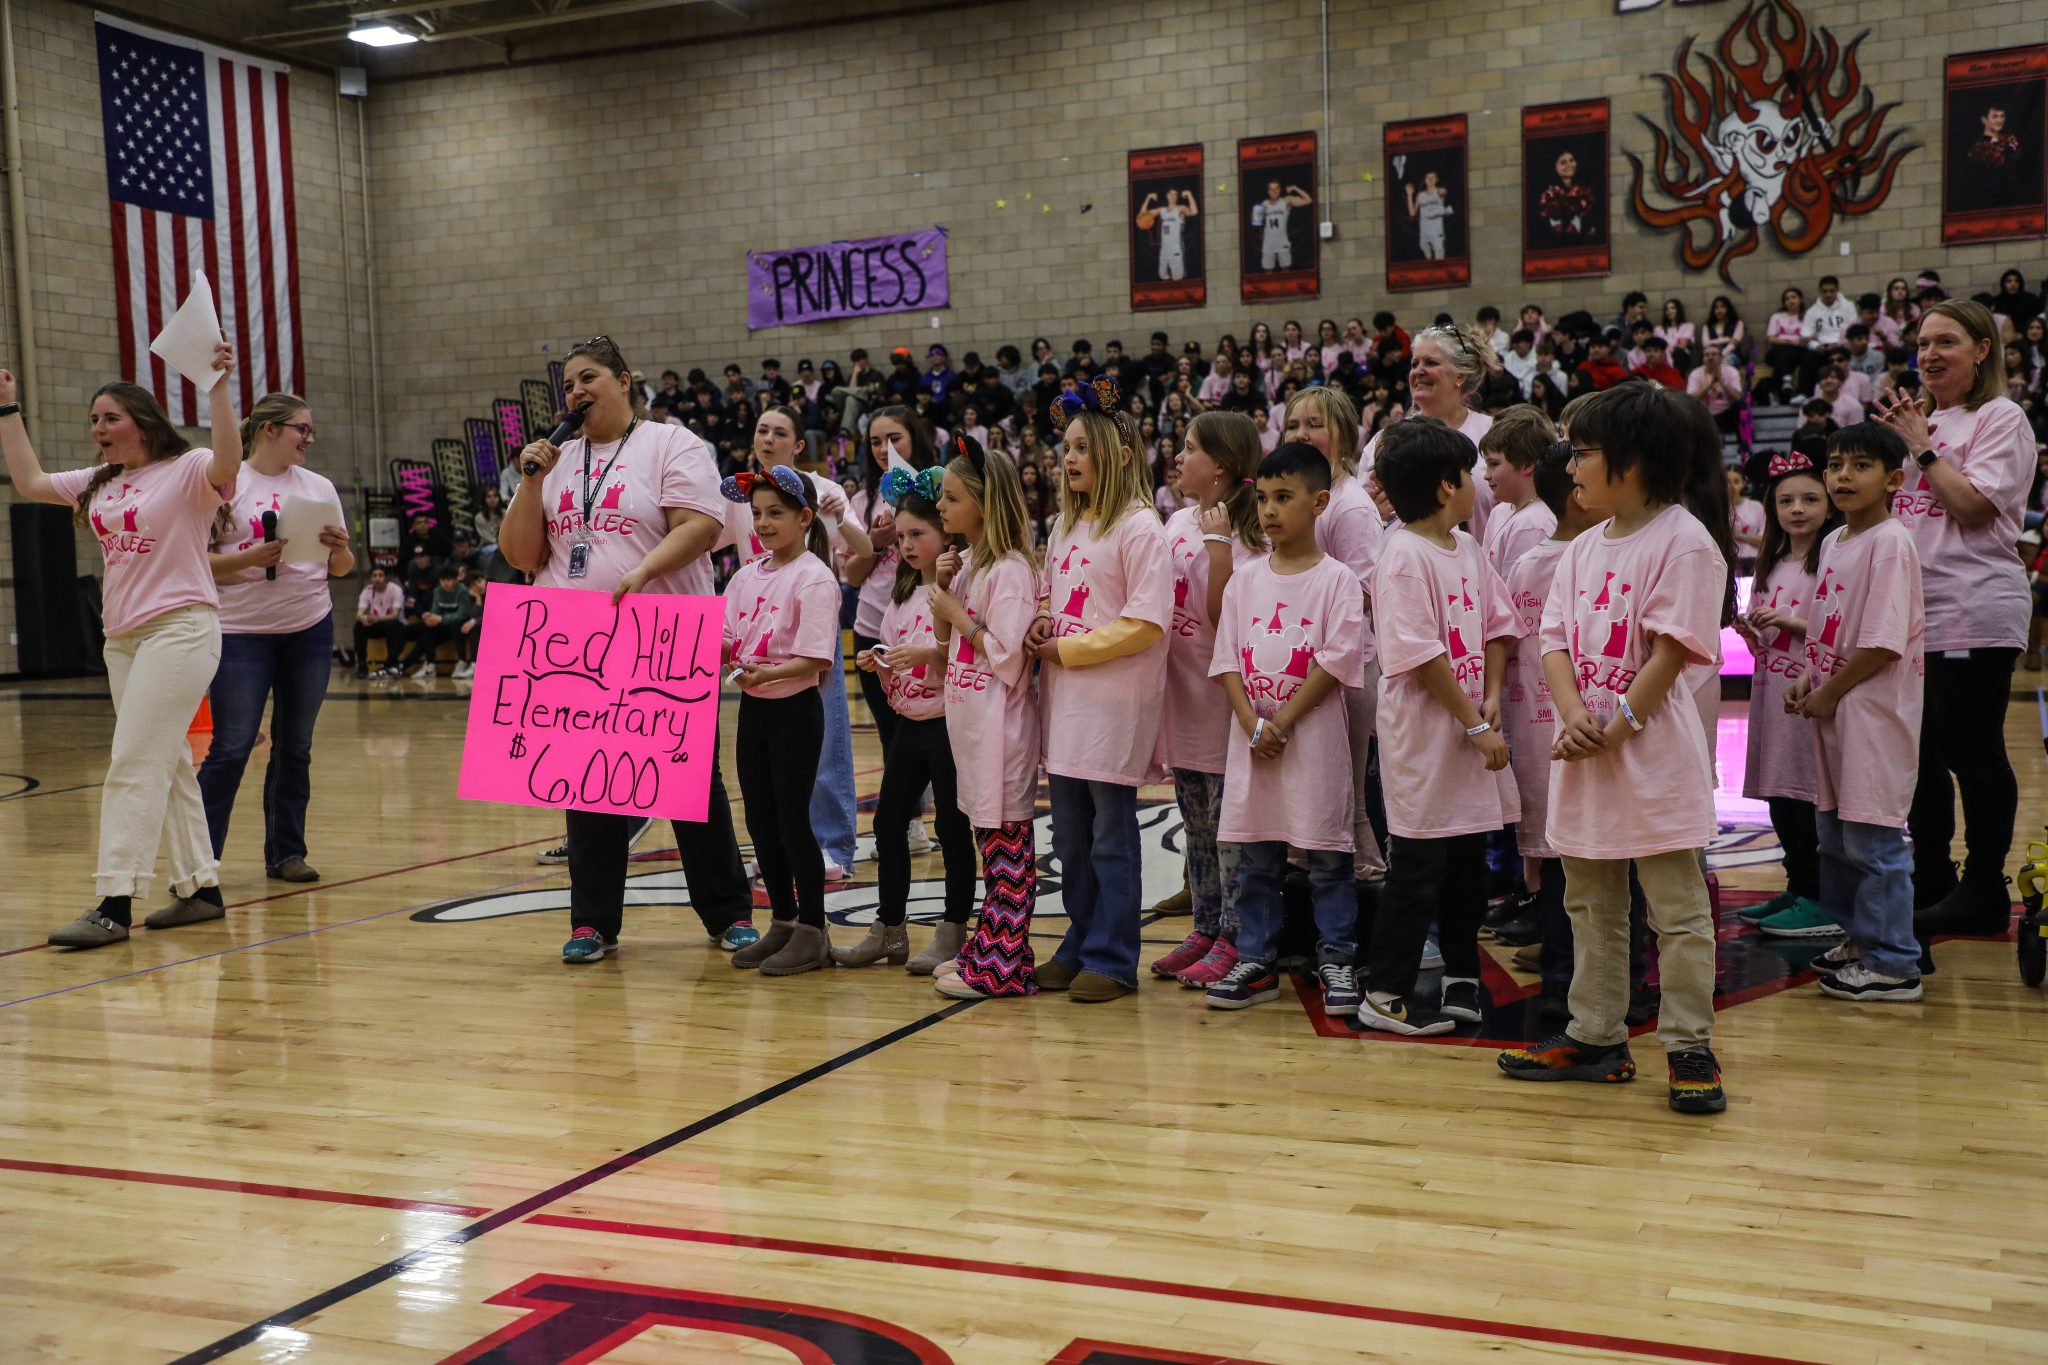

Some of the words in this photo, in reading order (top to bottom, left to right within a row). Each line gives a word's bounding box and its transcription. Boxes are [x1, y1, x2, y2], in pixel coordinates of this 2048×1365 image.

[772, 241, 926, 320] PRINCESS
[516, 600, 619, 679] Red
[493, 675, 690, 753] Elementary
